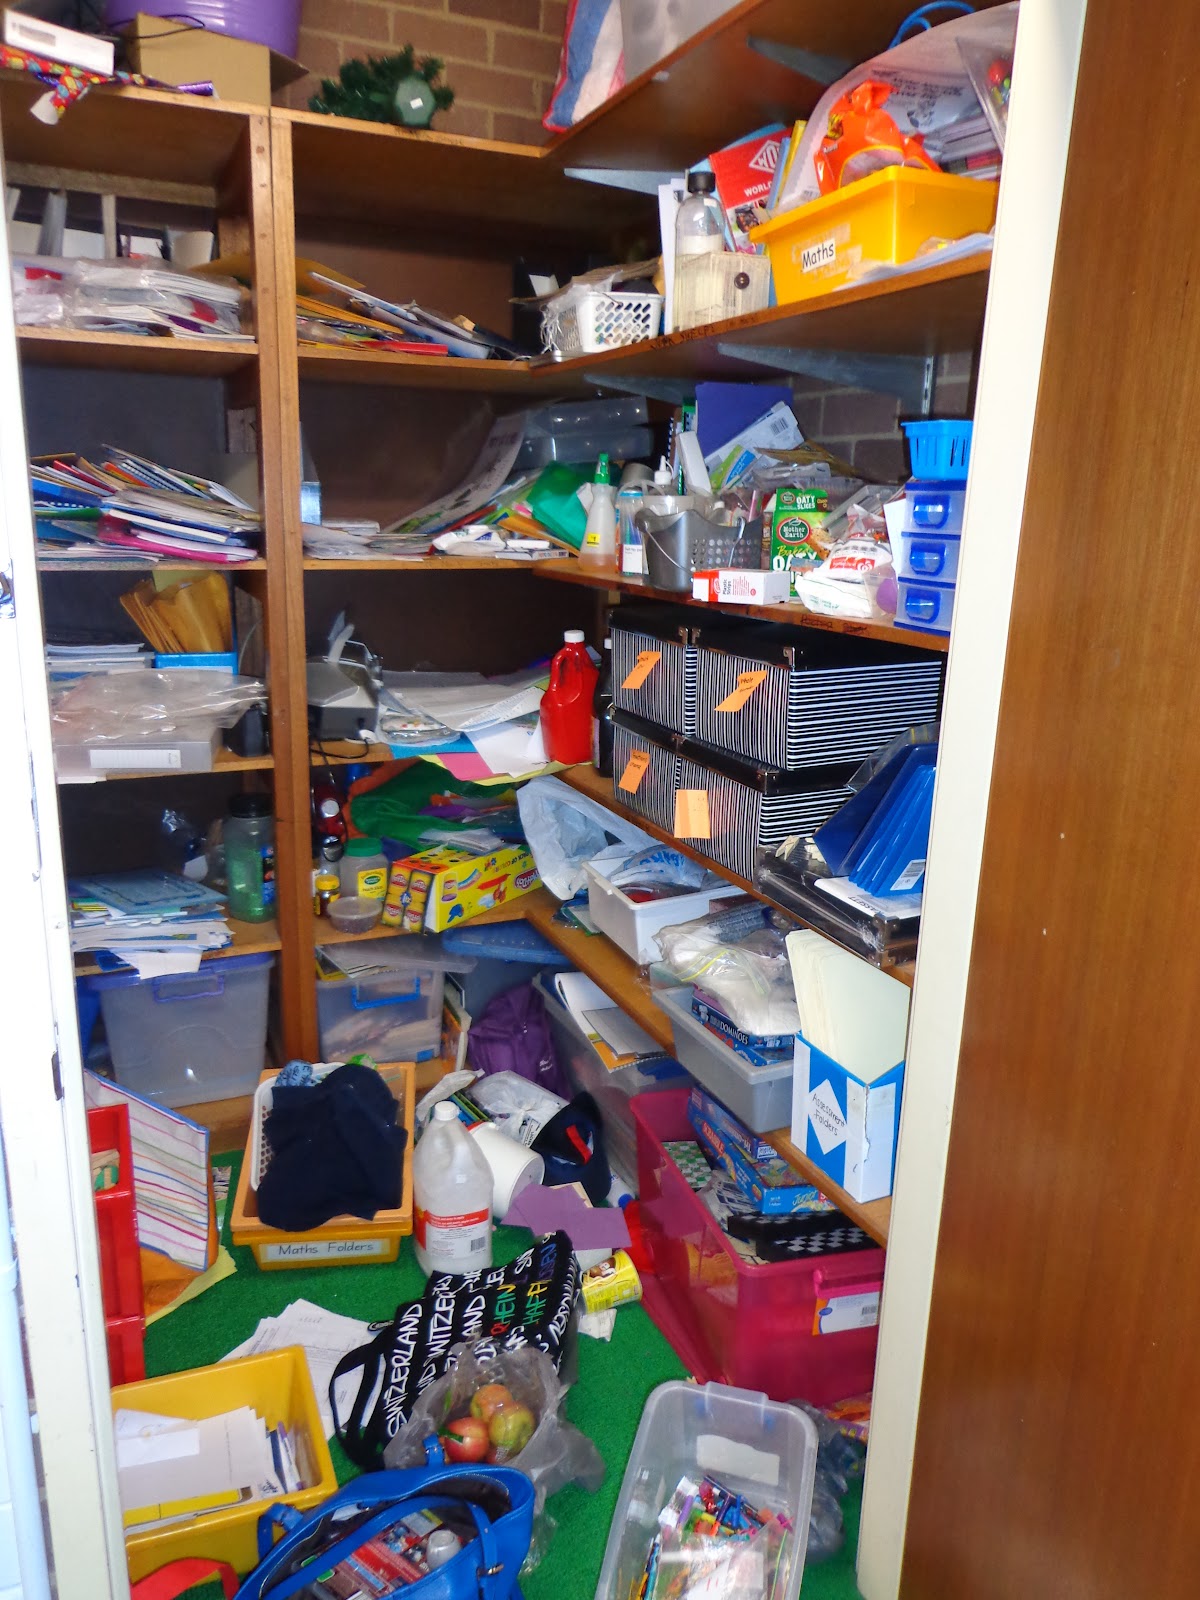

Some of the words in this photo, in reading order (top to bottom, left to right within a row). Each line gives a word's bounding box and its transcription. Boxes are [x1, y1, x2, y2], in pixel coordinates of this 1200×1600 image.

[756, 143, 780, 172] WO
[802, 242, 835, 269] Maths
[796, 495, 815, 504] OATY
[783, 525, 806, 533] Mother
[720, 1021, 748, 1046] DOMINOES
[814, 1109, 839, 1136] Folders
[278, 1244, 319, 1256] Maths
[327, 1241, 374, 1253] Folders
[383, 1303, 423, 1438] SWITZERLAND
